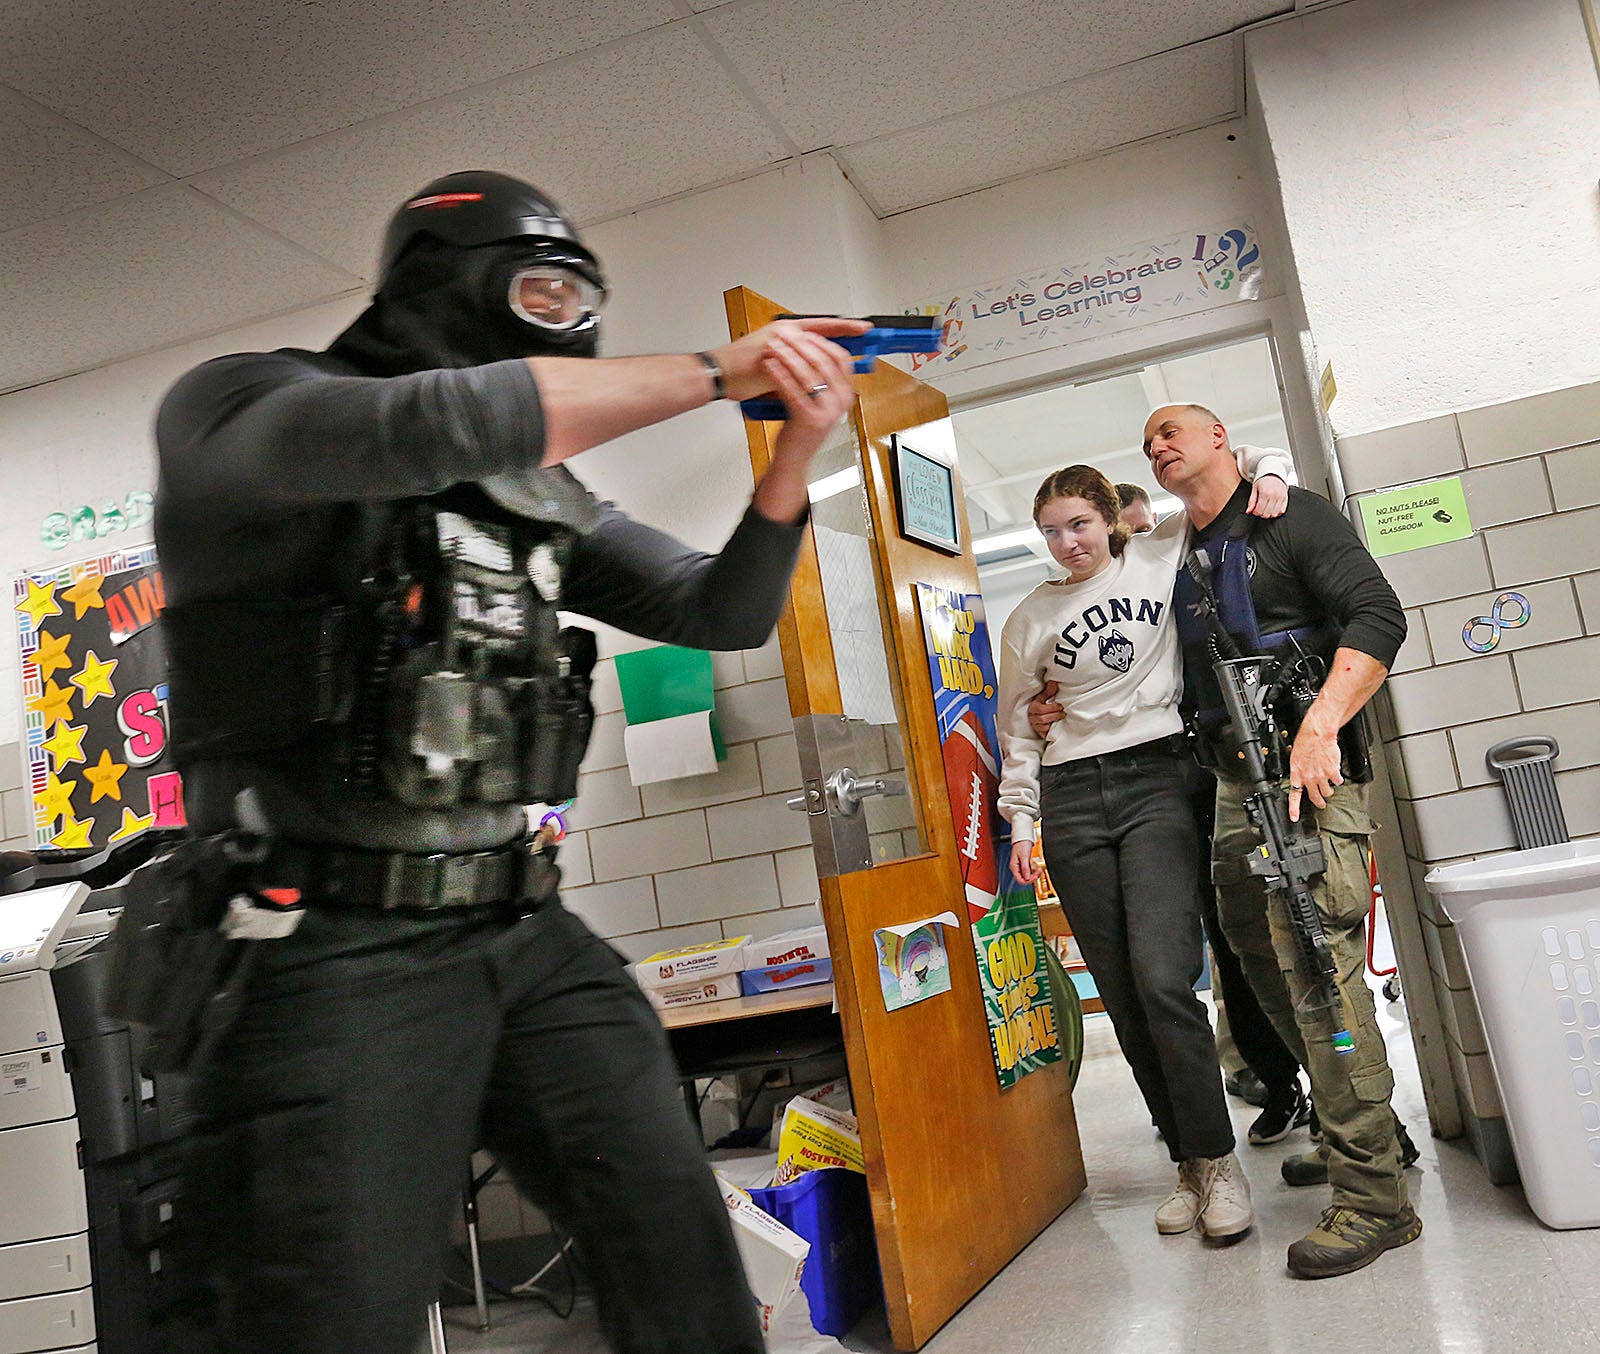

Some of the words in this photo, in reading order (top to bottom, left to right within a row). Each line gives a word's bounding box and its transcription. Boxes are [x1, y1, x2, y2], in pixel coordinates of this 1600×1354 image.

[1191, 234, 1206, 261] 1
[1218, 229, 1259, 272] 2
[972, 292, 1036, 320] Let's
[1043, 255, 1183, 301] Celebrate
[1214, 268, 1235, 290] 3
[1019, 285, 1142, 327] Learning
[1376, 507, 1387, 516] NO
[1389, 502, 1410, 513] NUTS
[1412, 496, 1440, 509] PLEASE!
[1378, 513, 1414, 525] NUT-FREE
[1380, 522, 1423, 535] CLASSROOM
[1054, 598, 1164, 670] UCONN
[676, 955, 717, 968] FLAGSHIP
[987, 932, 1037, 990] GOOD
[993, 1005, 1057, 1071] HAPPEN!
[744, 1204, 786, 1232] FLAGSHIP
